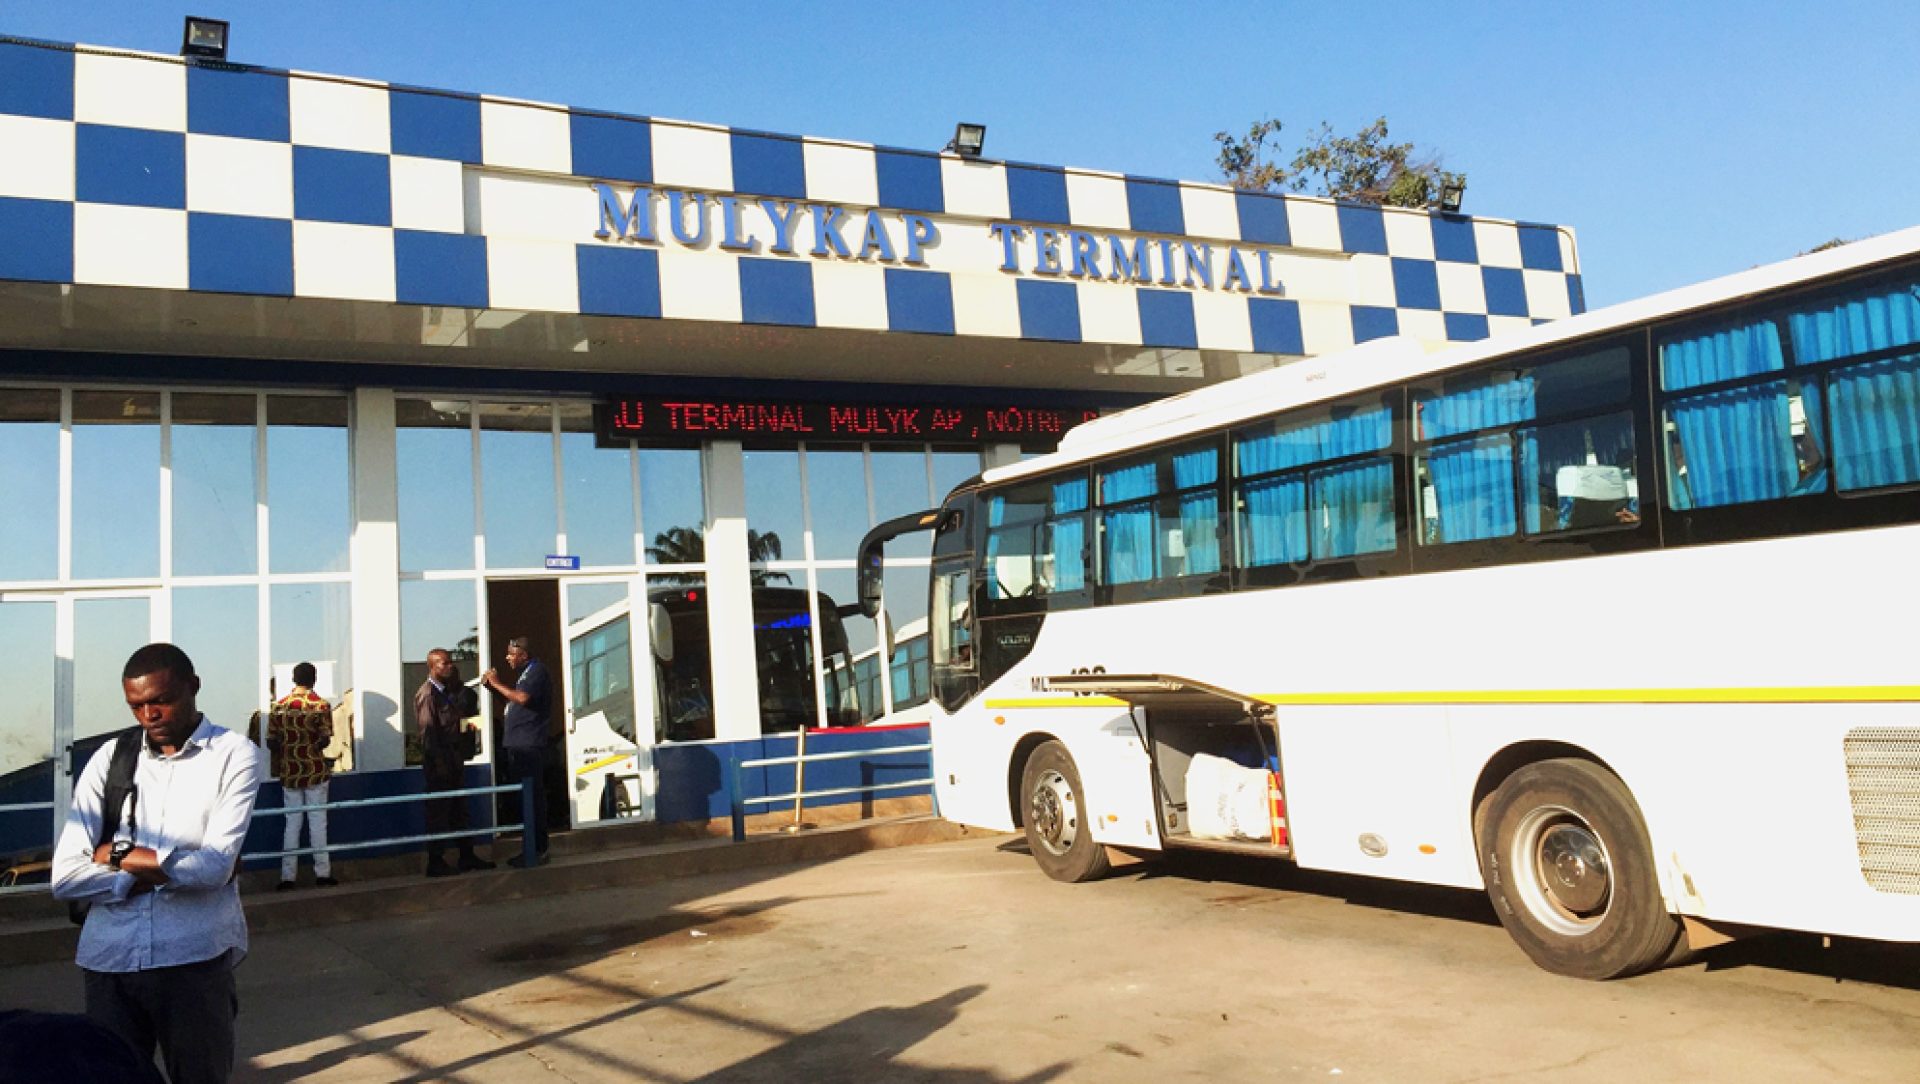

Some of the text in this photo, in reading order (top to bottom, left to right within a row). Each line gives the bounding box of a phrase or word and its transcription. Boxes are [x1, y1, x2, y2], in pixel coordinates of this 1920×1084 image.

[593, 184, 1285, 295] MULYKAP TERMINAL
[662, 403, 814, 432] TERMINAL
